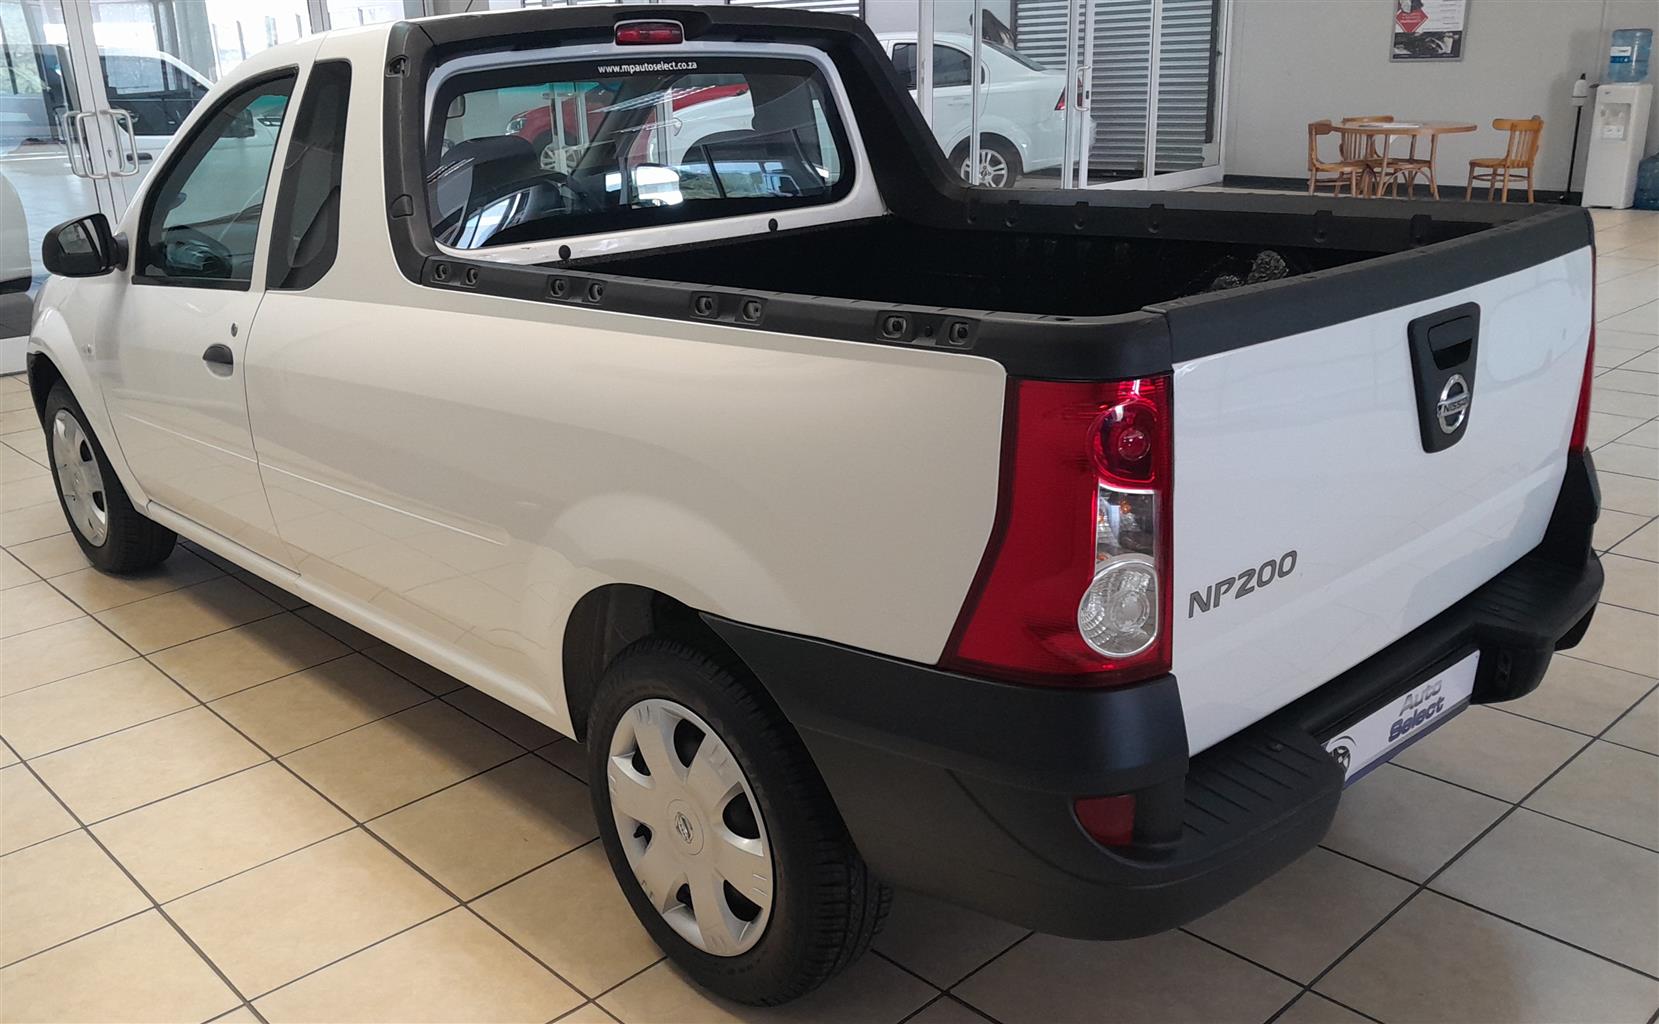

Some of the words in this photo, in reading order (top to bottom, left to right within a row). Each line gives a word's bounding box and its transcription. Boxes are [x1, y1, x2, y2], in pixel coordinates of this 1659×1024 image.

[598, 61, 698, 74] www.mpautoselect.co.za
[1188, 550, 1298, 619] NP200
[1399, 679, 1443, 717] Auto
[1388, 696, 1445, 743] Select
